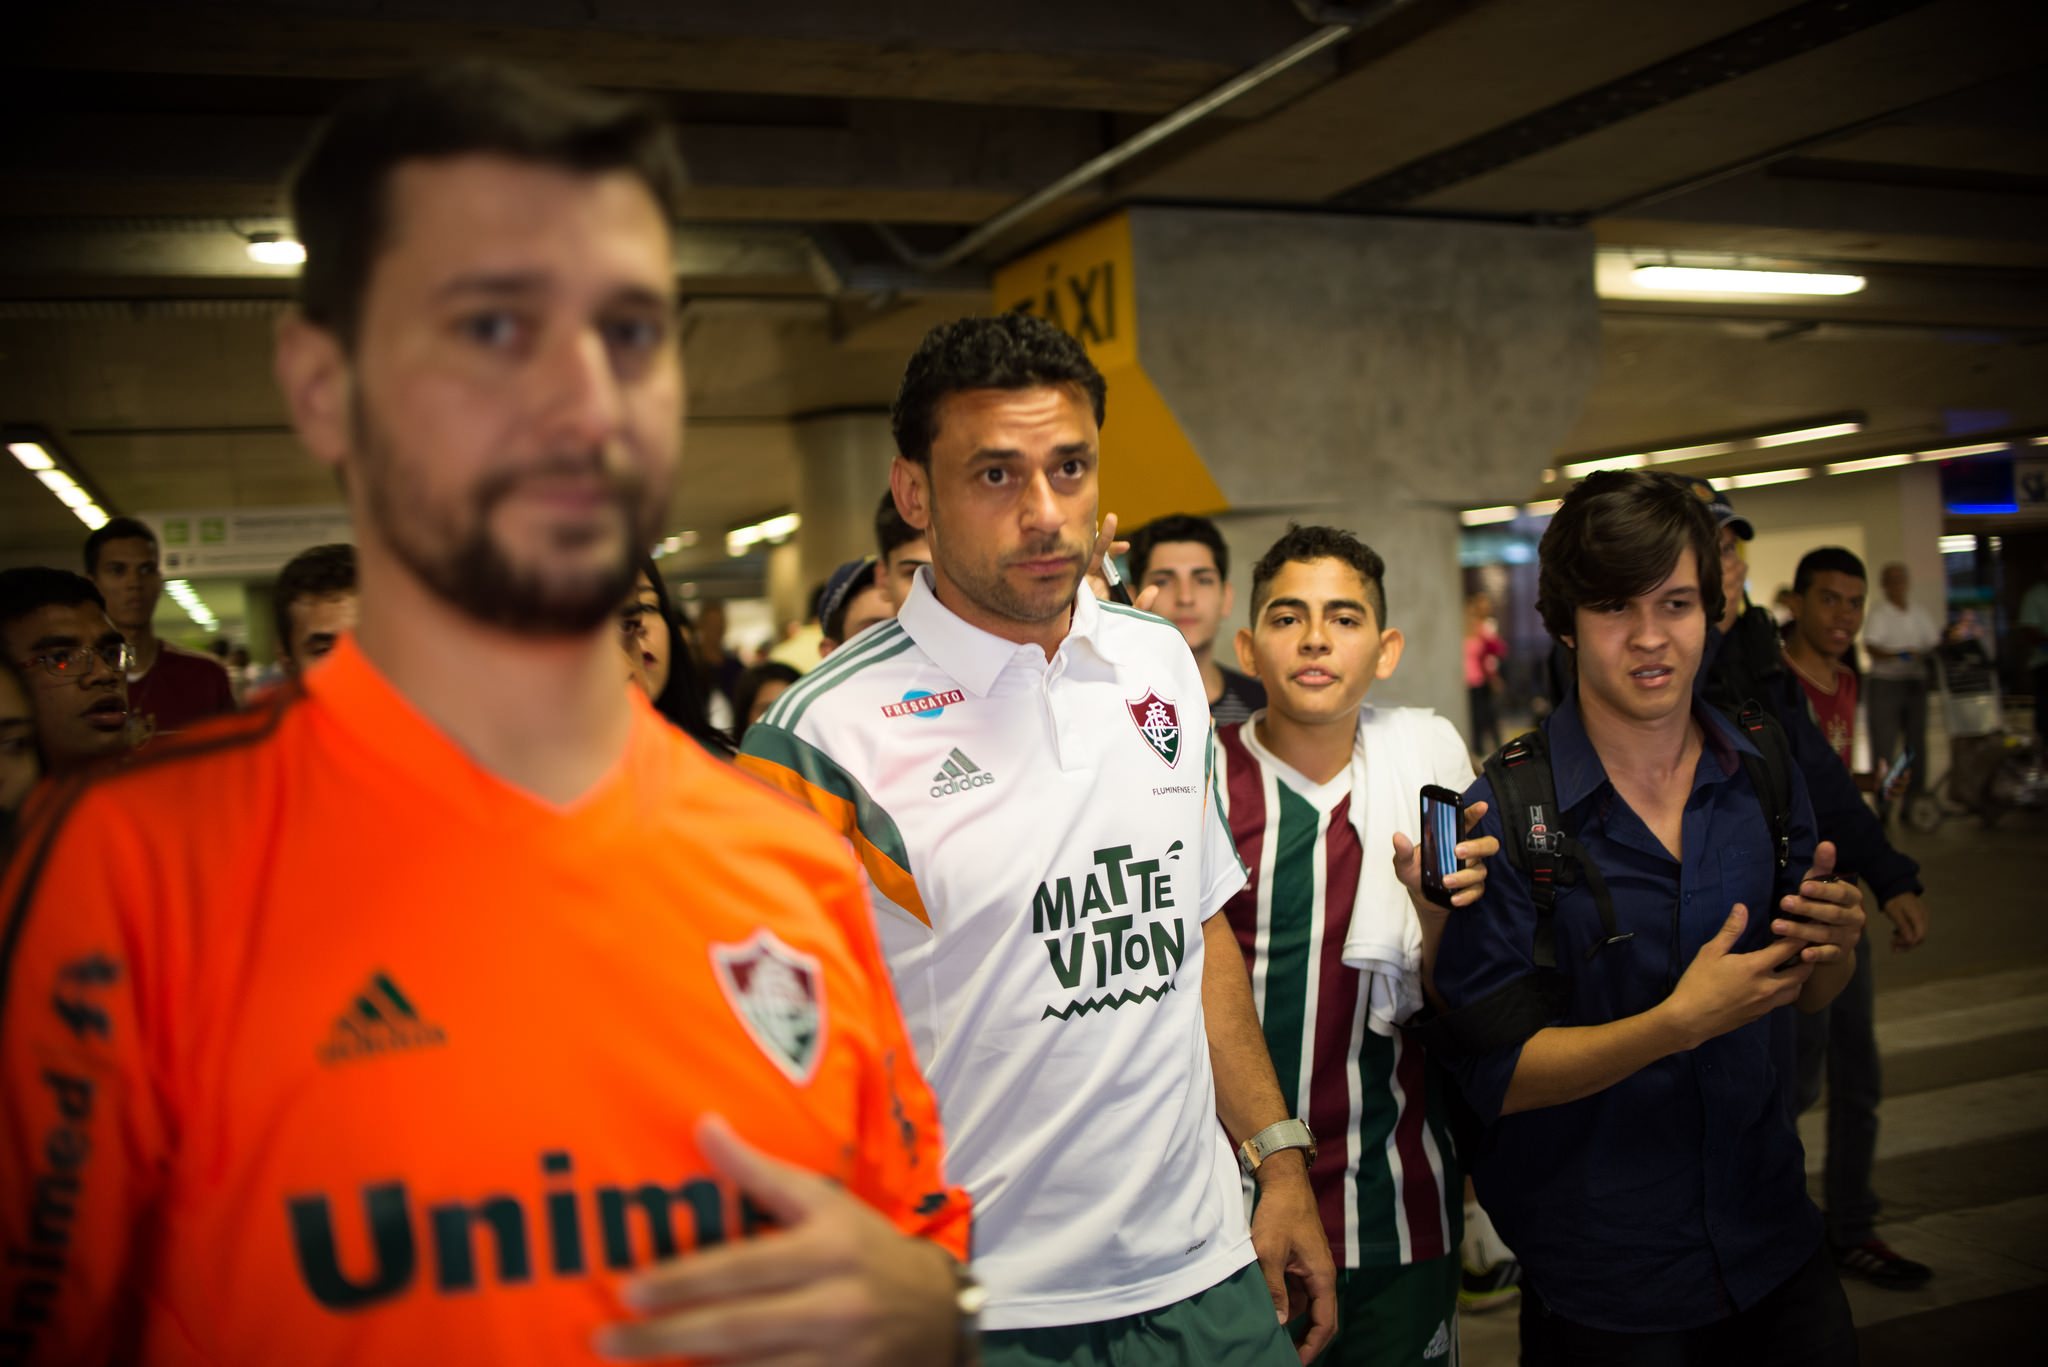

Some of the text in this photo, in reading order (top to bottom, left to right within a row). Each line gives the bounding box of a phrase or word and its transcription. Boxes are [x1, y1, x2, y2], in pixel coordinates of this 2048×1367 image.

[1013, 262, 1116, 342] ÁXI
[884, 691, 960, 717] FRESCATTO
[930, 772, 995, 798] adidas
[1152, 786, 1190, 796] FLUMINENSE
[1032, 844, 1175, 934] MATTE
[1044, 914, 1185, 989] VITON
[287, 1150, 780, 1317] Unim
